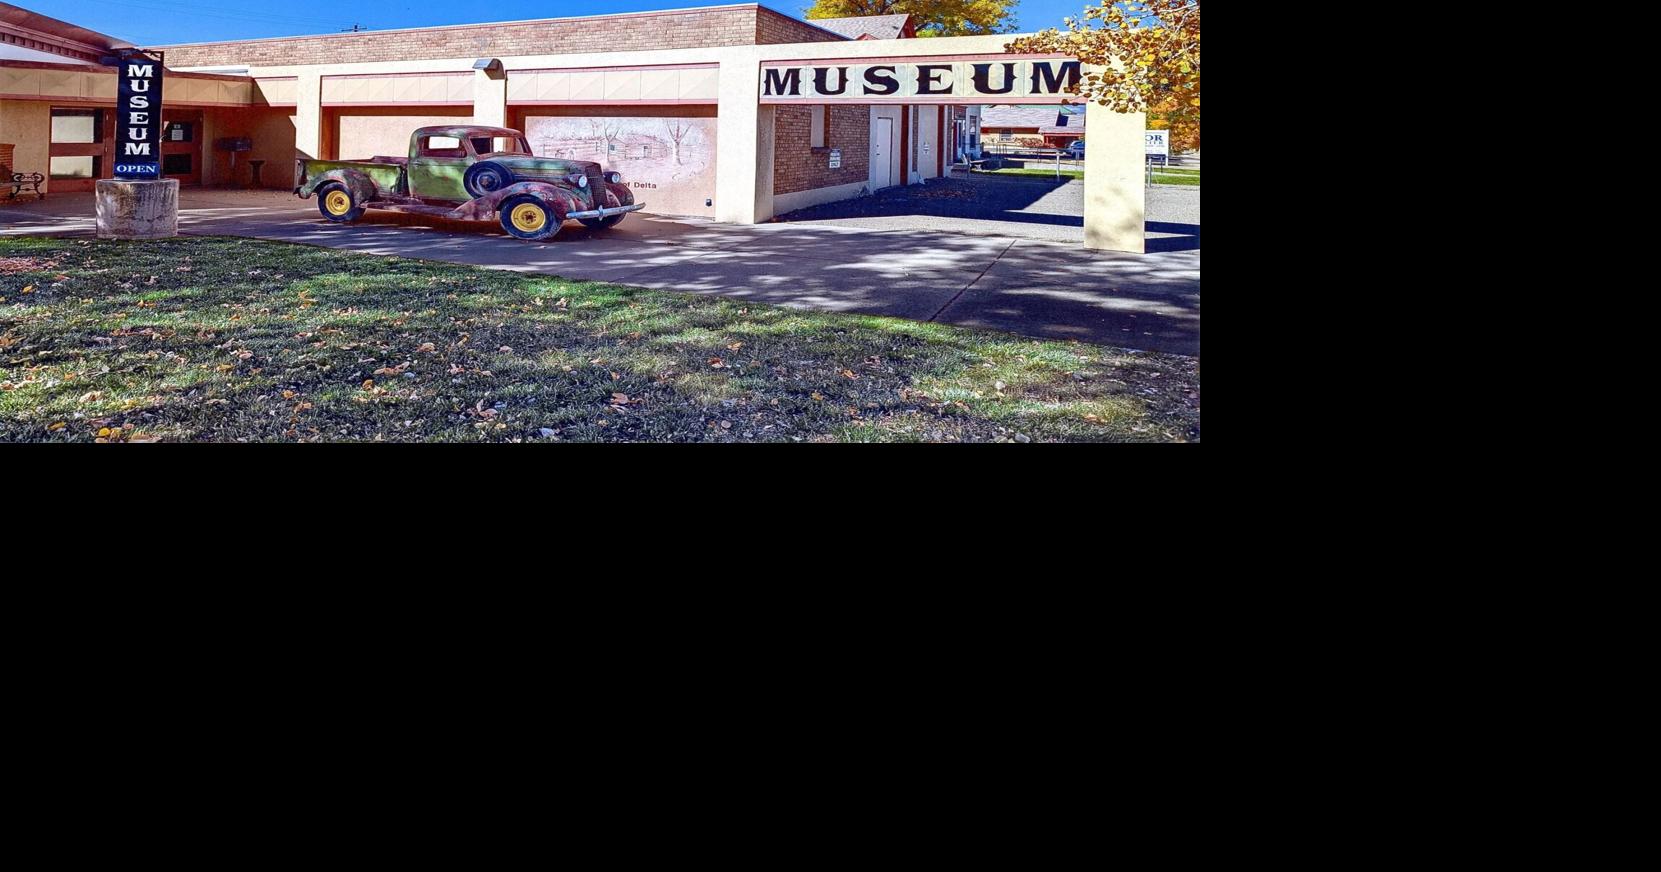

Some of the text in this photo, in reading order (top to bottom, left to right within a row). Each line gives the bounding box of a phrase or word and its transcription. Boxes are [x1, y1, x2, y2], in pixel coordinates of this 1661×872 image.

[763, 61, 1084, 95] MUSEUM
[125, 64, 153, 155] MUSEUM
[116, 164, 156, 173] OPEN
